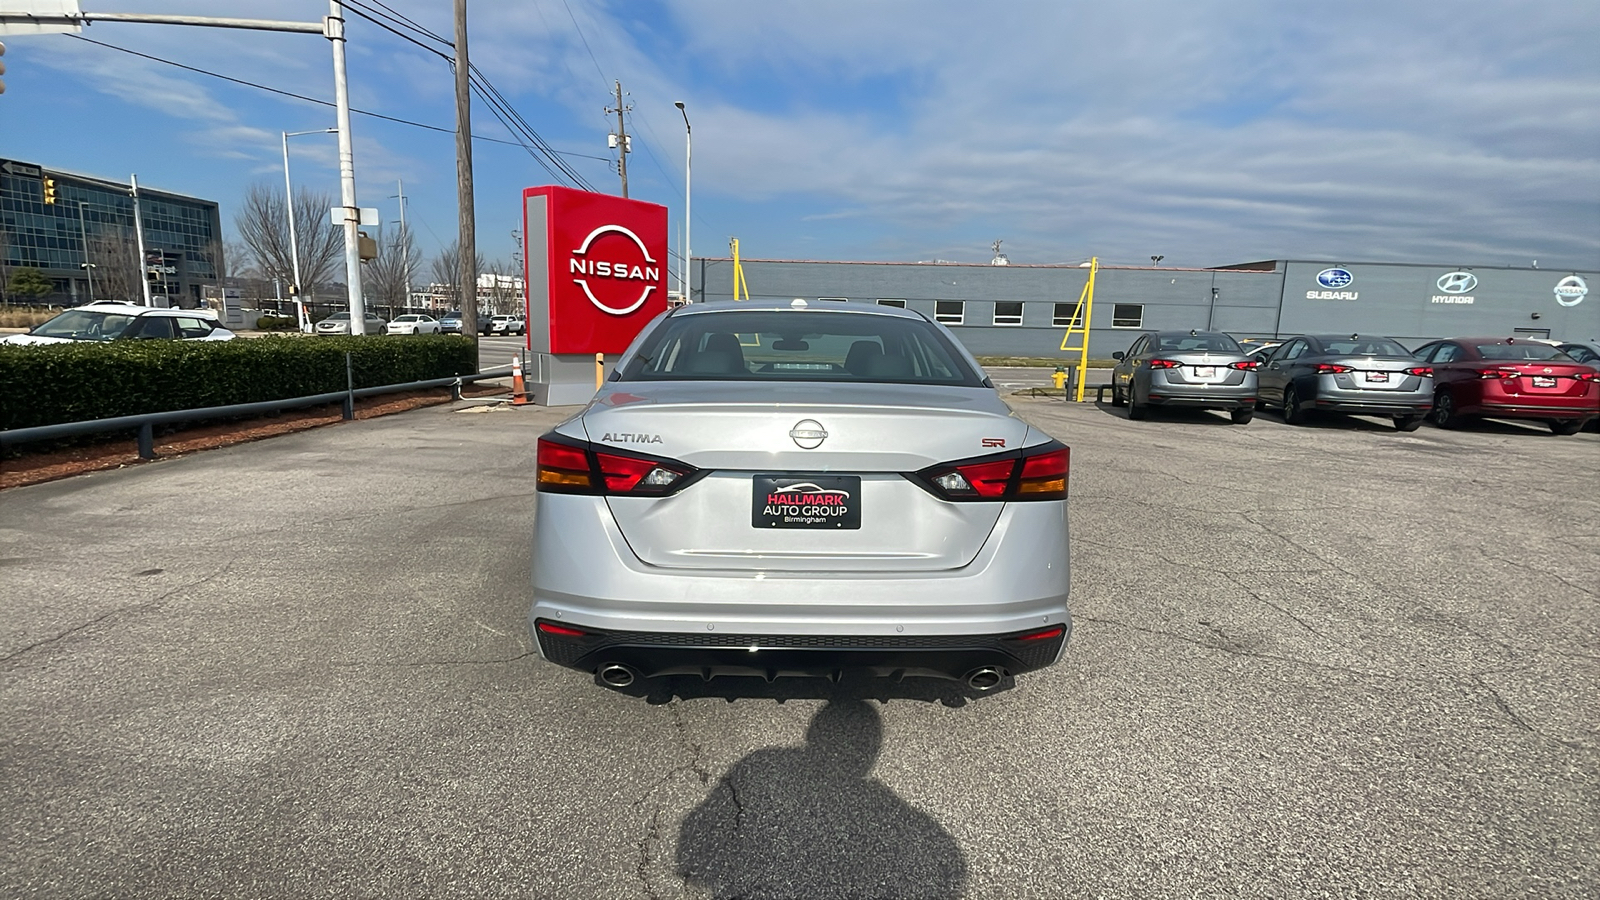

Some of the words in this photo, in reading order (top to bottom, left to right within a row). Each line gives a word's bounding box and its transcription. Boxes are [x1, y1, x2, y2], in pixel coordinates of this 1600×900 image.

[570, 258, 659, 281] NISSAN
[1306, 291, 1358, 300] SUBARU
[1432, 295, 1474, 304] HYUNDAI
[601, 433, 663, 444] ALTIMA
[982, 438, 1006, 448] SR
[767, 494, 844, 506] HALLMARK
[763, 505, 799, 516] AUTO
[802, 505, 848, 517] GROUP
[784, 516, 827, 524] Birmingham
